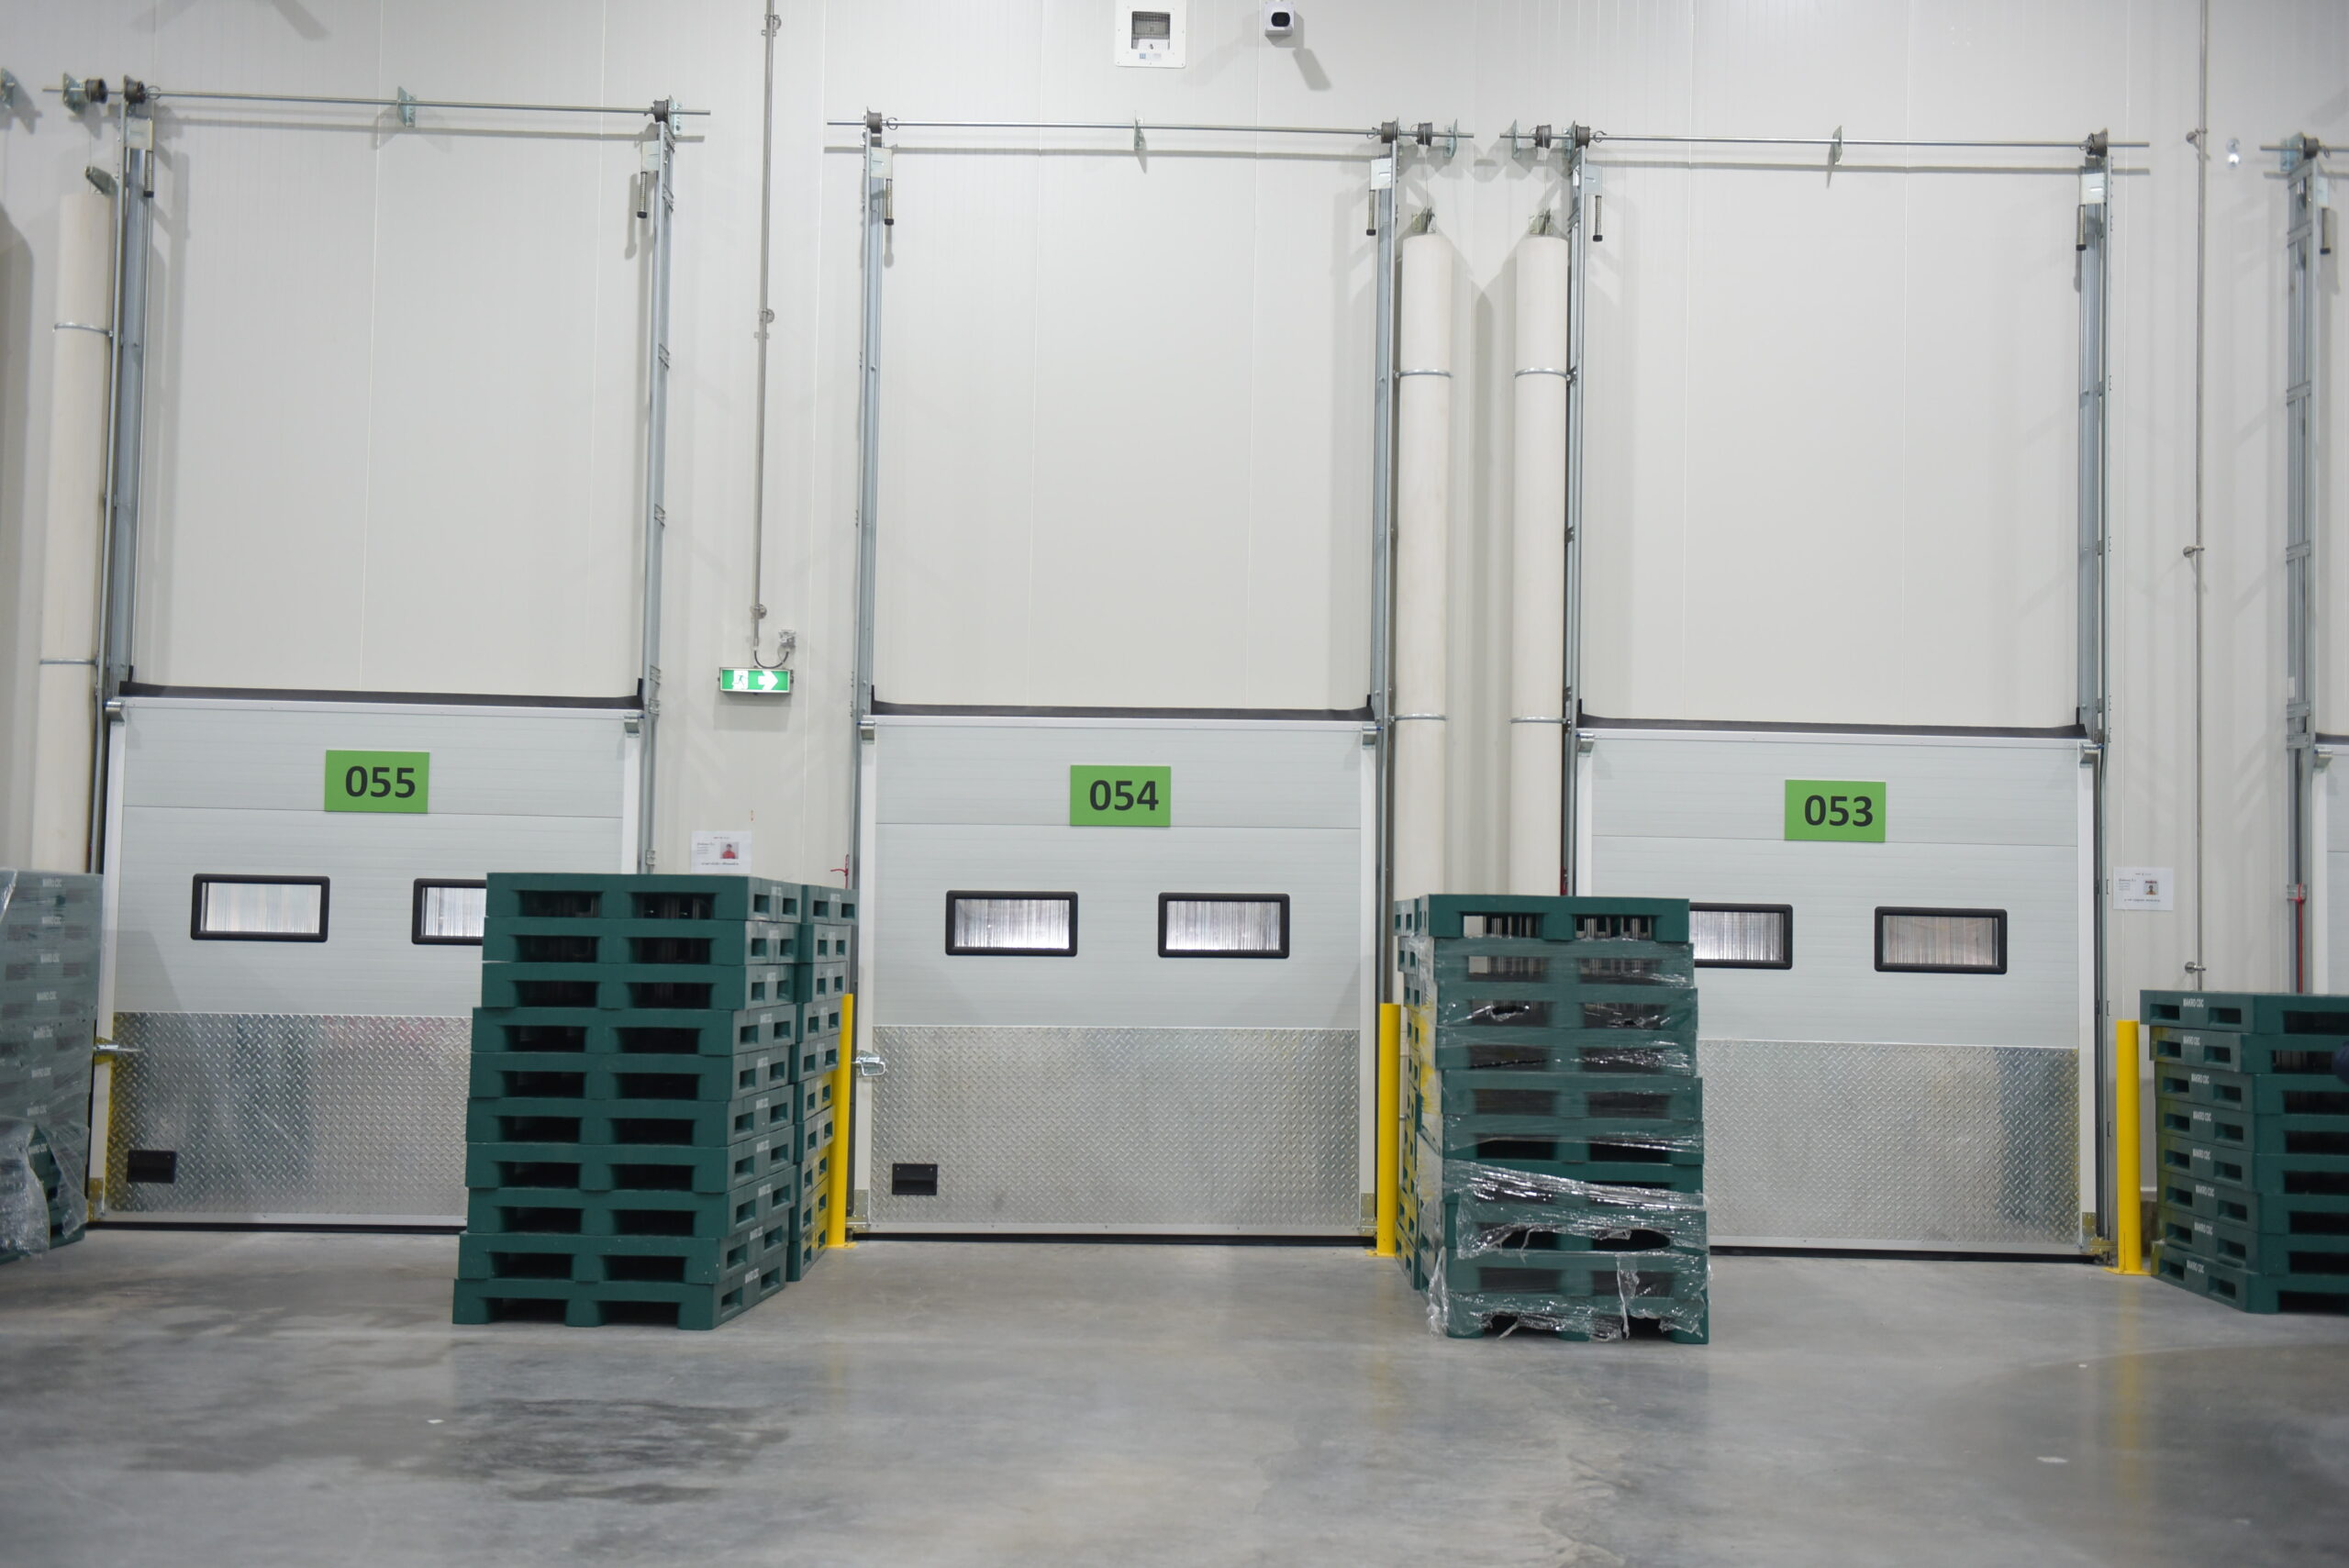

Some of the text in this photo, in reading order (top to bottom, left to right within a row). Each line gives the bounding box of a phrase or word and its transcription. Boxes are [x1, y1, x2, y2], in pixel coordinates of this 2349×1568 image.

[345, 765, 416, 799] 055
[1089, 779, 1159, 811] 054
[1804, 795, 1874, 828] 053
[2183, 998, 2196, 1007] MAKRO
